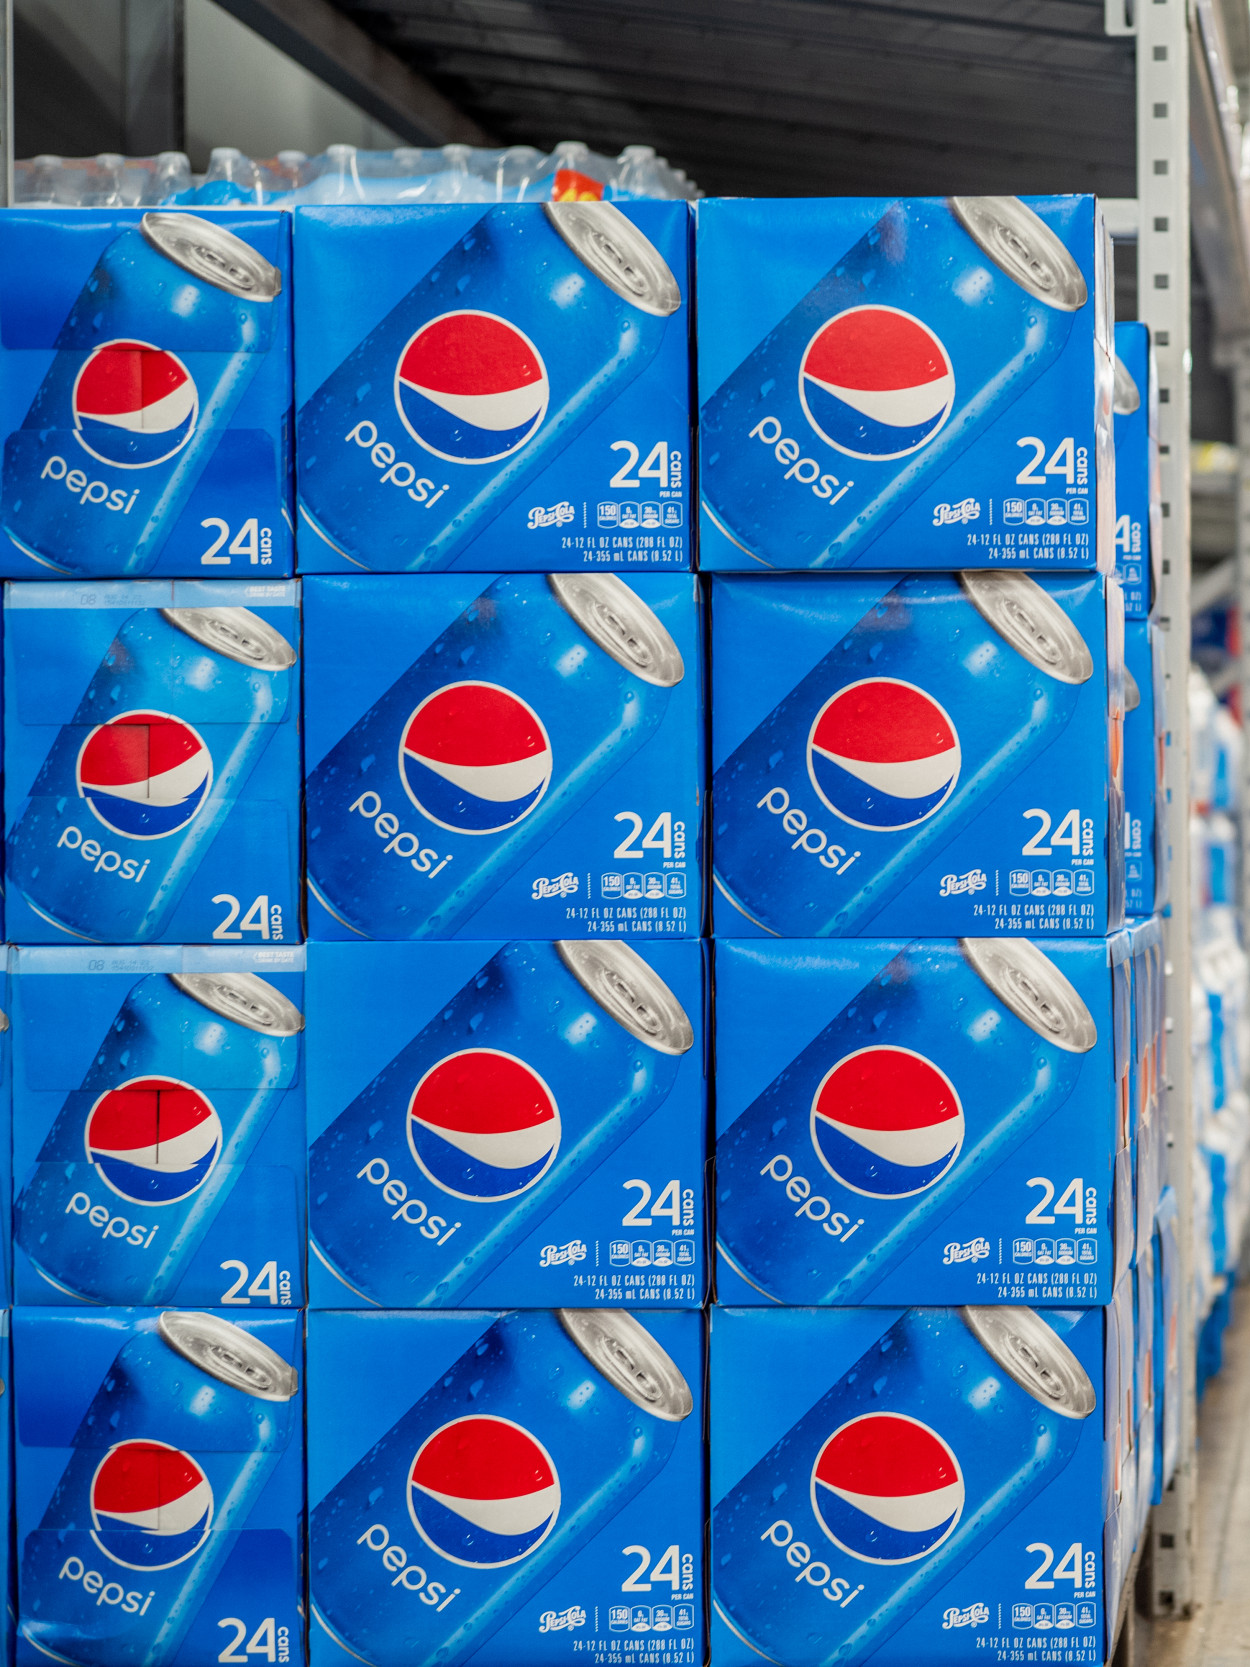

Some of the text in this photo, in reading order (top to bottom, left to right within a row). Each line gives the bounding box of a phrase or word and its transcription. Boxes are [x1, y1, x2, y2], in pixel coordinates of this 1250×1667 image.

[344, 420, 450, 509] pepsi
[610, 440, 681, 488] 24 cans
[748, 416, 854, 506] pepsi
[1016, 436, 1088, 485] 24 cans
[40, 455, 140, 514] pepsi
[1006, 502, 1022, 512] 150
[600, 506, 616, 515] 150
[200, 518, 272, 565] 24 cans
[562, 537, 584, 548] 24-12
[588, 537, 596, 548] FL
[600, 537, 609, 548] OZ
[613, 537, 633, 548] CANS
[657, 537, 665, 548] FL
[584, 551, 610, 562] 24-355
[628, 551, 648, 562] CANS
[967, 534, 990, 545] 24-12
[994, 534, 1002, 545] FL
[1005, 534, 1015, 545] OZ
[1019, 534, 1039, 545] CANS
[1063, 534, 1071, 545] FL
[989, 548, 1016, 559] 24-355
[1034, 548, 1054, 559] CANS
[348, 790, 453, 879] pepsi
[613, 811, 685, 859] 24 cans
[756, 786, 861, 876] pepsi
[1022, 808, 1094, 856] 24 cans
[56, 825, 152, 883] pepsi
[604, 876, 620, 886] 150
[1012, 873, 1028, 883] 150
[211, 894, 284, 941] 24 cans
[566, 908, 588, 918] 24-12
[592, 908, 600, 918] FL
[604, 908, 613, 918] OZ
[617, 908, 637, 918] CANS
[661, 908, 669, 918] FL
[588, 921, 614, 932] 24-355
[632, 922, 652, 932] CANS
[974, 905, 996, 915] 24-12
[1000, 905, 1008, 915] FL
[1012, 905, 1021, 915] OZ
[1024, 905, 1045, 915] CANS
[1069, 905, 1076, 915] FL
[995, 918, 1022, 929] 24-355
[1039, 919, 1060, 929] CANS
[65, 1191, 160, 1249] pepsi
[356, 1157, 461, 1246] pepsi
[622, 1179, 694, 1226] 24 cans
[759, 1154, 865, 1243] pepsi
[1025, 1176, 1097, 1225] 24 cans
[612, 1244, 628, 1253] 150
[1015, 1242, 1031, 1251] 150
[220, 1260, 292, 1306] 24 cans
[574, 1275, 596, 1286] 24-12
[600, 1275, 608, 1286] FL
[612, 1275, 621, 1286] OZ
[625, 1275, 645, 1286] CANS
[669, 1275, 677, 1286] FL
[596, 1289, 622, 1300] 24-355
[640, 1289, 660, 1300] CANS
[977, 1273, 999, 1284] 24-12
[1003, 1273, 1011, 1284] FL
[1015, 1273, 1024, 1284] OZ
[1028, 1273, 1048, 1284] CANS
[1072, 1274, 1079, 1284] FL
[998, 1287, 1025, 1298] 24-355
[1043, 1287, 1063, 1298] CANS
[58, 1556, 156, 1616] pepsi
[356, 1523, 461, 1612] pepsi
[621, 1544, 693, 1591] 24 cans
[760, 1519, 865, 1609] pepsi
[1024, 1542, 1096, 1589] 24 cans
[611, 1609, 628, 1619] 150
[1014, 1606, 1031, 1616] 150
[217, 1618, 290, 1663] 24 cans
[573, 1641, 596, 1651] 24-12
[599, 1640, 608, 1651] FL
[611, 1640, 621, 1651] OZ
[624, 1640, 645, 1651] CANS
[669, 1639, 676, 1650] FL
[976, 1638, 999, 1648] 24-12
[1002, 1638, 1010, 1648] FL
[1014, 1637, 1023, 1648] OZ
[1027, 1637, 1047, 1648] CANS
[1071, 1637, 1079, 1648] FL
[998, 1651, 1024, 1662] 24-355
[1042, 1651, 1062, 1661] CANS
